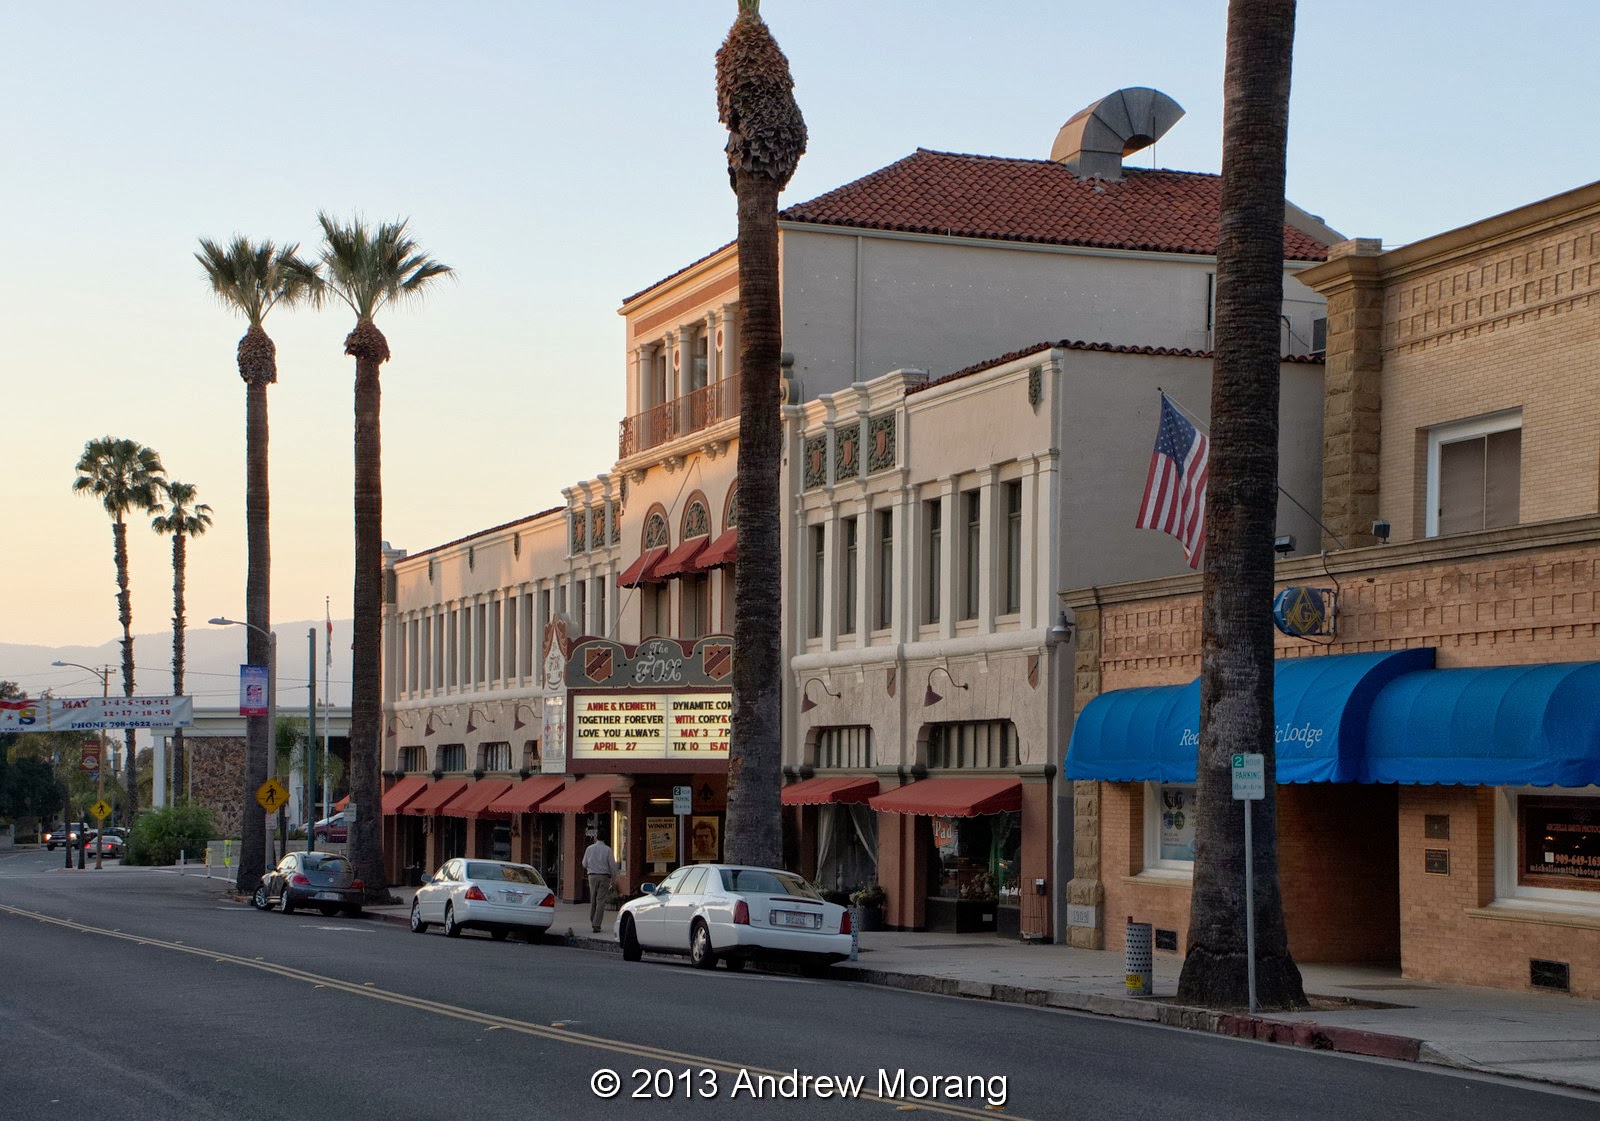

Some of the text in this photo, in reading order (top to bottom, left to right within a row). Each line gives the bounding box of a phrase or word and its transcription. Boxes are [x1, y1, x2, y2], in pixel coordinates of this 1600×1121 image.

[649, 641, 668, 654] The
[62, 699, 89, 709] MAY
[587, 701, 657, 711] ANNE & KENNETH
[673, 701, 714, 710] DYNAMITE
[577, 715, 664, 724] TOGETHER FOREVER
[675, 715, 695, 724] WITH
[71, 721, 107, 729] PHONE
[578, 729, 660, 738] LOVE YOU ALWAYS
[680, 728, 699, 738] MAY
[702, 729, 709, 737] 3
[1283, 722, 1323, 749] Lodge
[593, 742, 637, 751] APRIL 27
[673, 742, 687, 751] TIX
[689, 742, 699, 751] 10
[1234, 756, 1261, 766] 2 HOUR
[1235, 771, 1261, 779] PARKING
